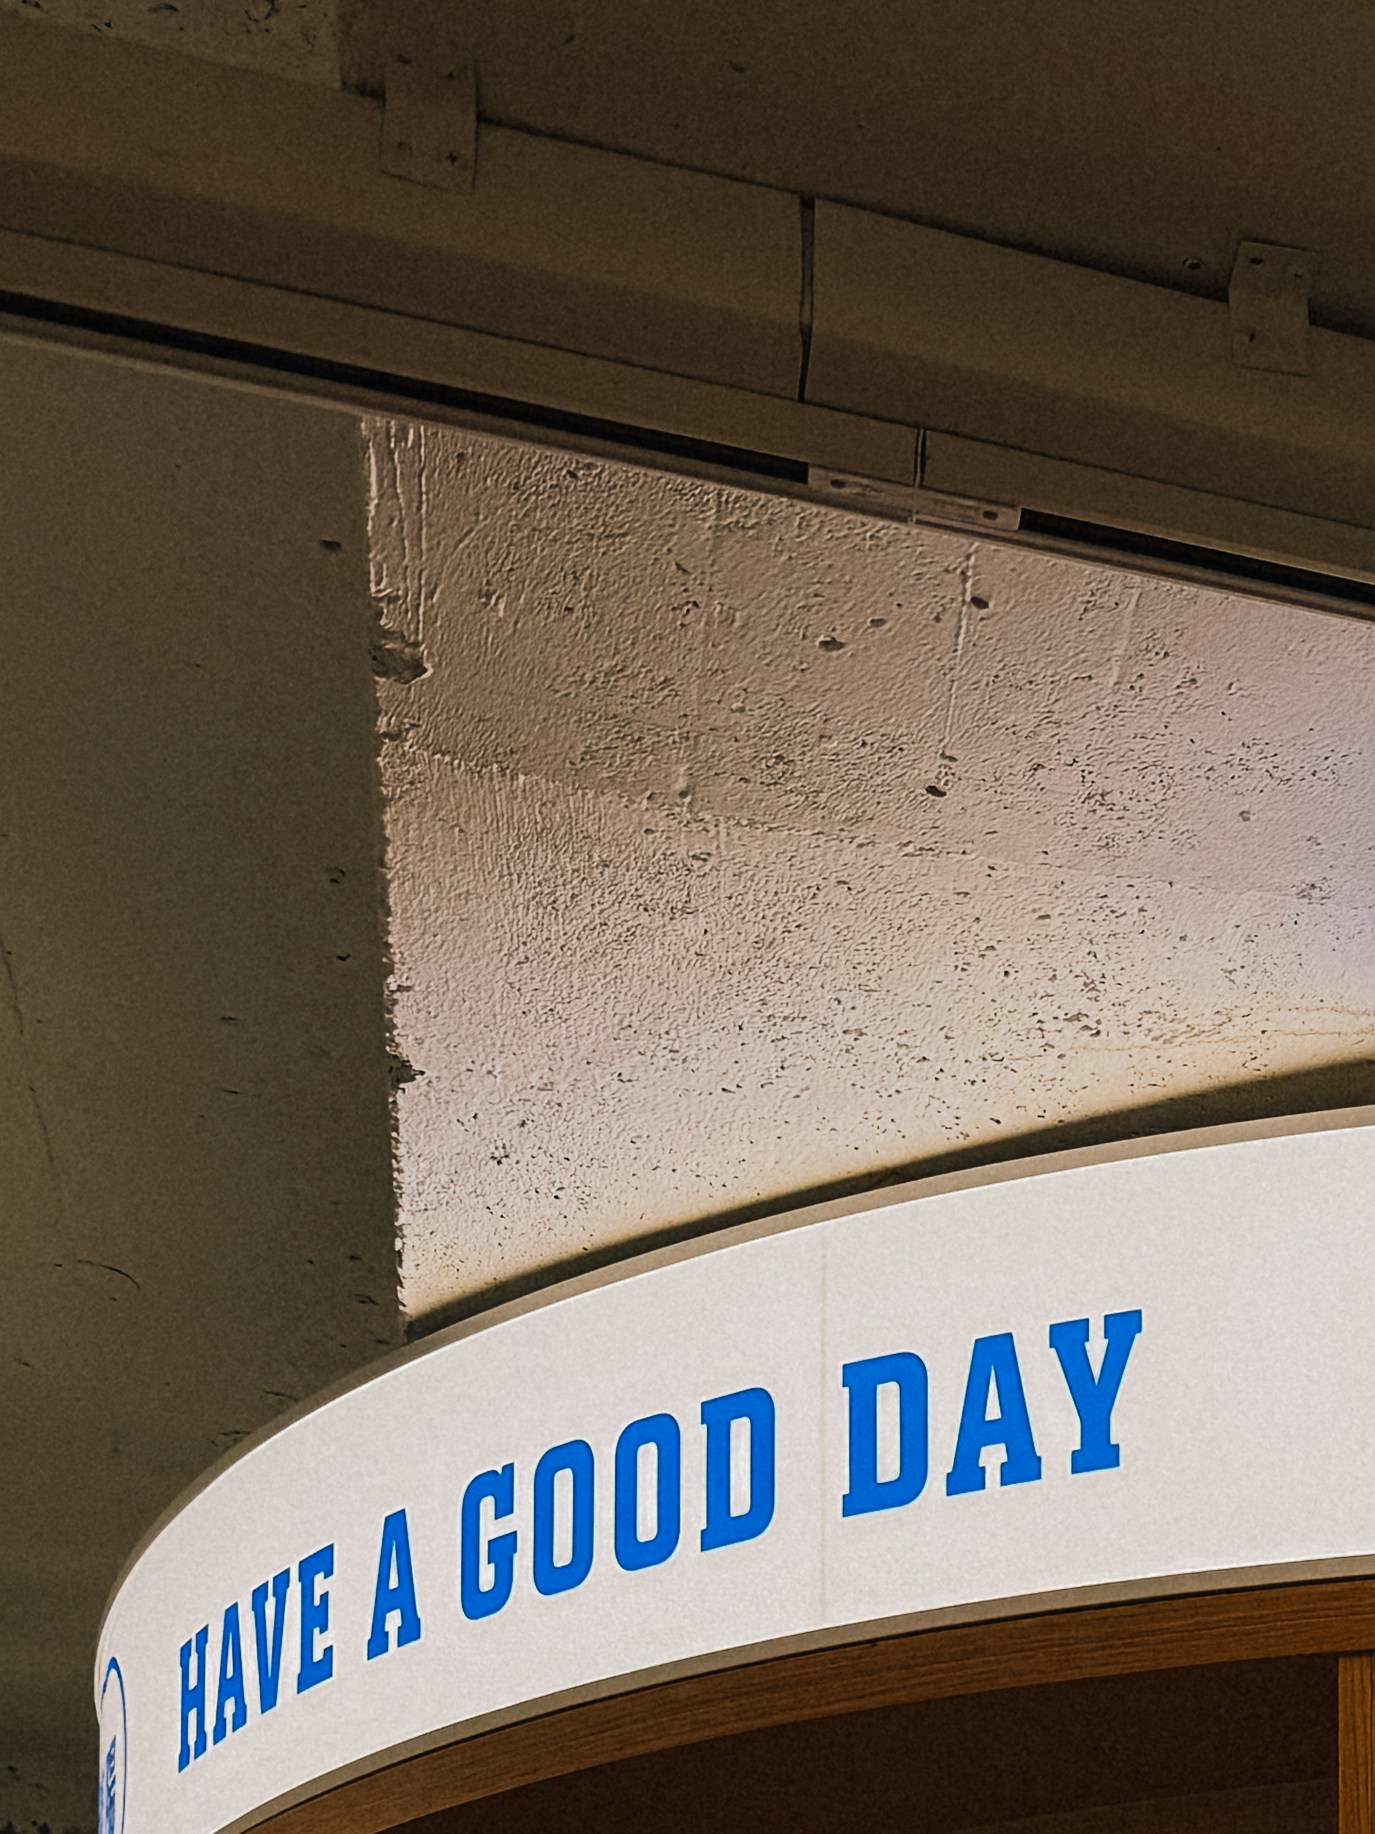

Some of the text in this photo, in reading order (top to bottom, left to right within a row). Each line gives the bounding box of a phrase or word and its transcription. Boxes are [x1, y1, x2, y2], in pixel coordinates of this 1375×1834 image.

[178, 1309, 1143, 1772] HAVE A GOOD DAY
